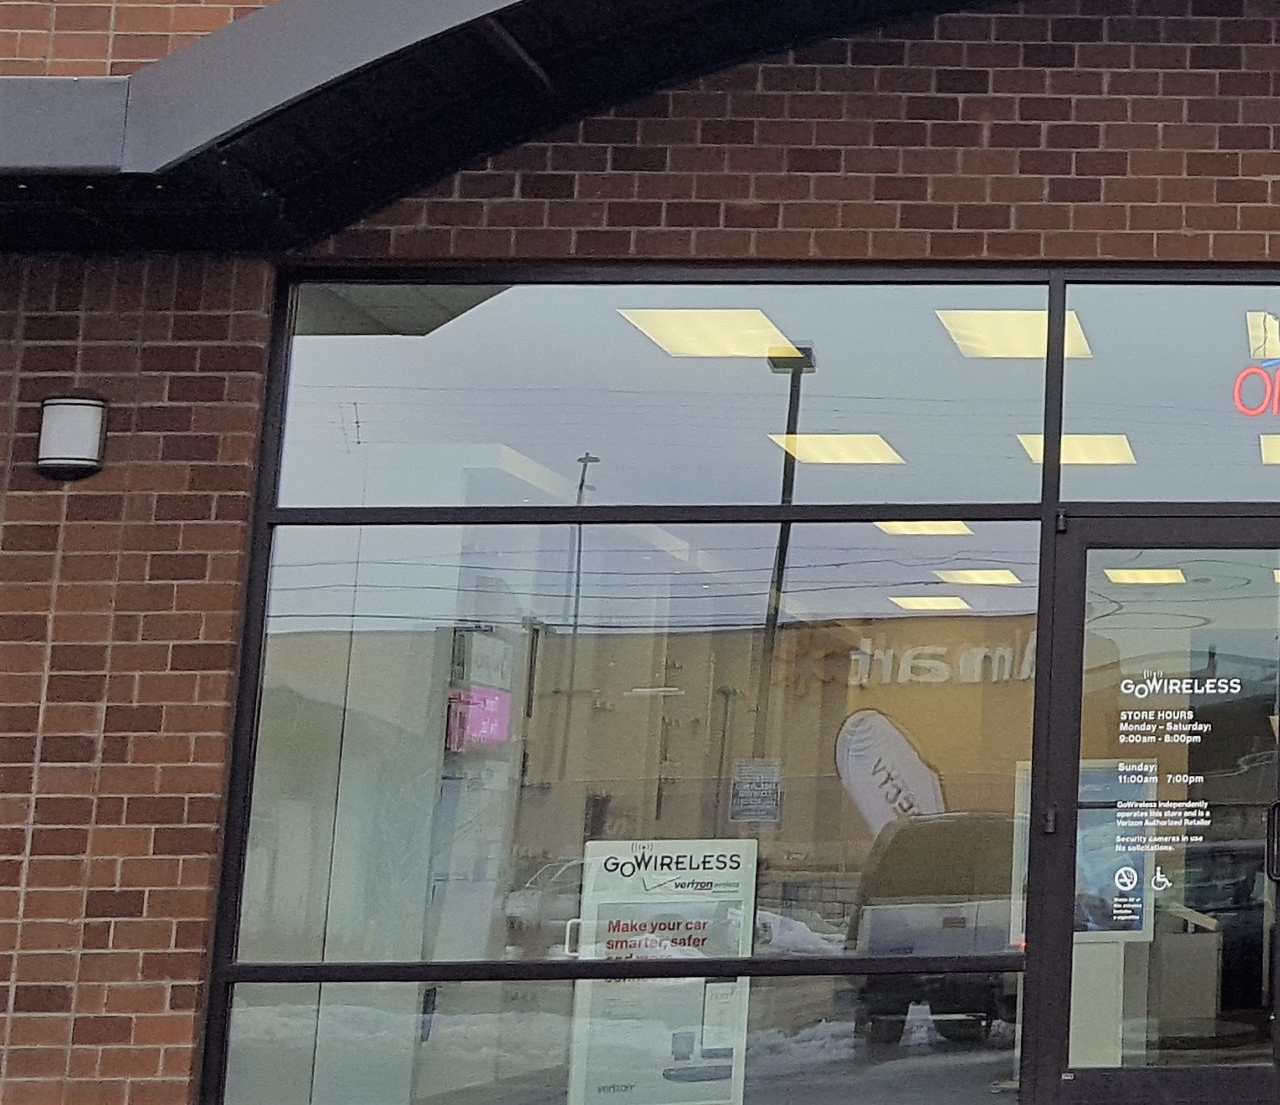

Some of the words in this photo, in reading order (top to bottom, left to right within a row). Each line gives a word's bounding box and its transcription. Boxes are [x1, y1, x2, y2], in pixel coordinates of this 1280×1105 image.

[1120, 674, 1242, 699] GOWIRELESS
[1120, 710, 1155, 720] STORE
[1157, 710, 1194, 720] HOURS
[1119, 722, 1157, 732] Monday
[1165, 722, 1212, 733] Saturday:
[1118, 734, 1156, 743] 9:00am
[1163, 734, 1202, 744] 8:00pm
[1118, 762, 1158, 773] Sunday:
[1117, 775, 1158, 784] 11:00am
[1166, 774, 1204, 785] 7:00pm
[1116, 810, 1148, 818] operates
[1197, 809, 1205, 817] is
[1116, 819, 1143, 827] Verizon
[1183, 818, 1212, 826] Retailer
[1116, 835, 1147, 843] Security
[603, 851, 741, 877] GOWIRELESS
[674, 879, 713, 890] verizon
[607, 919, 647, 933] Make
[649, 920, 682, 934] your
[685, 919, 708, 931] car
[606, 937, 667, 951] smarter,
[670, 934, 708, 948] safer
